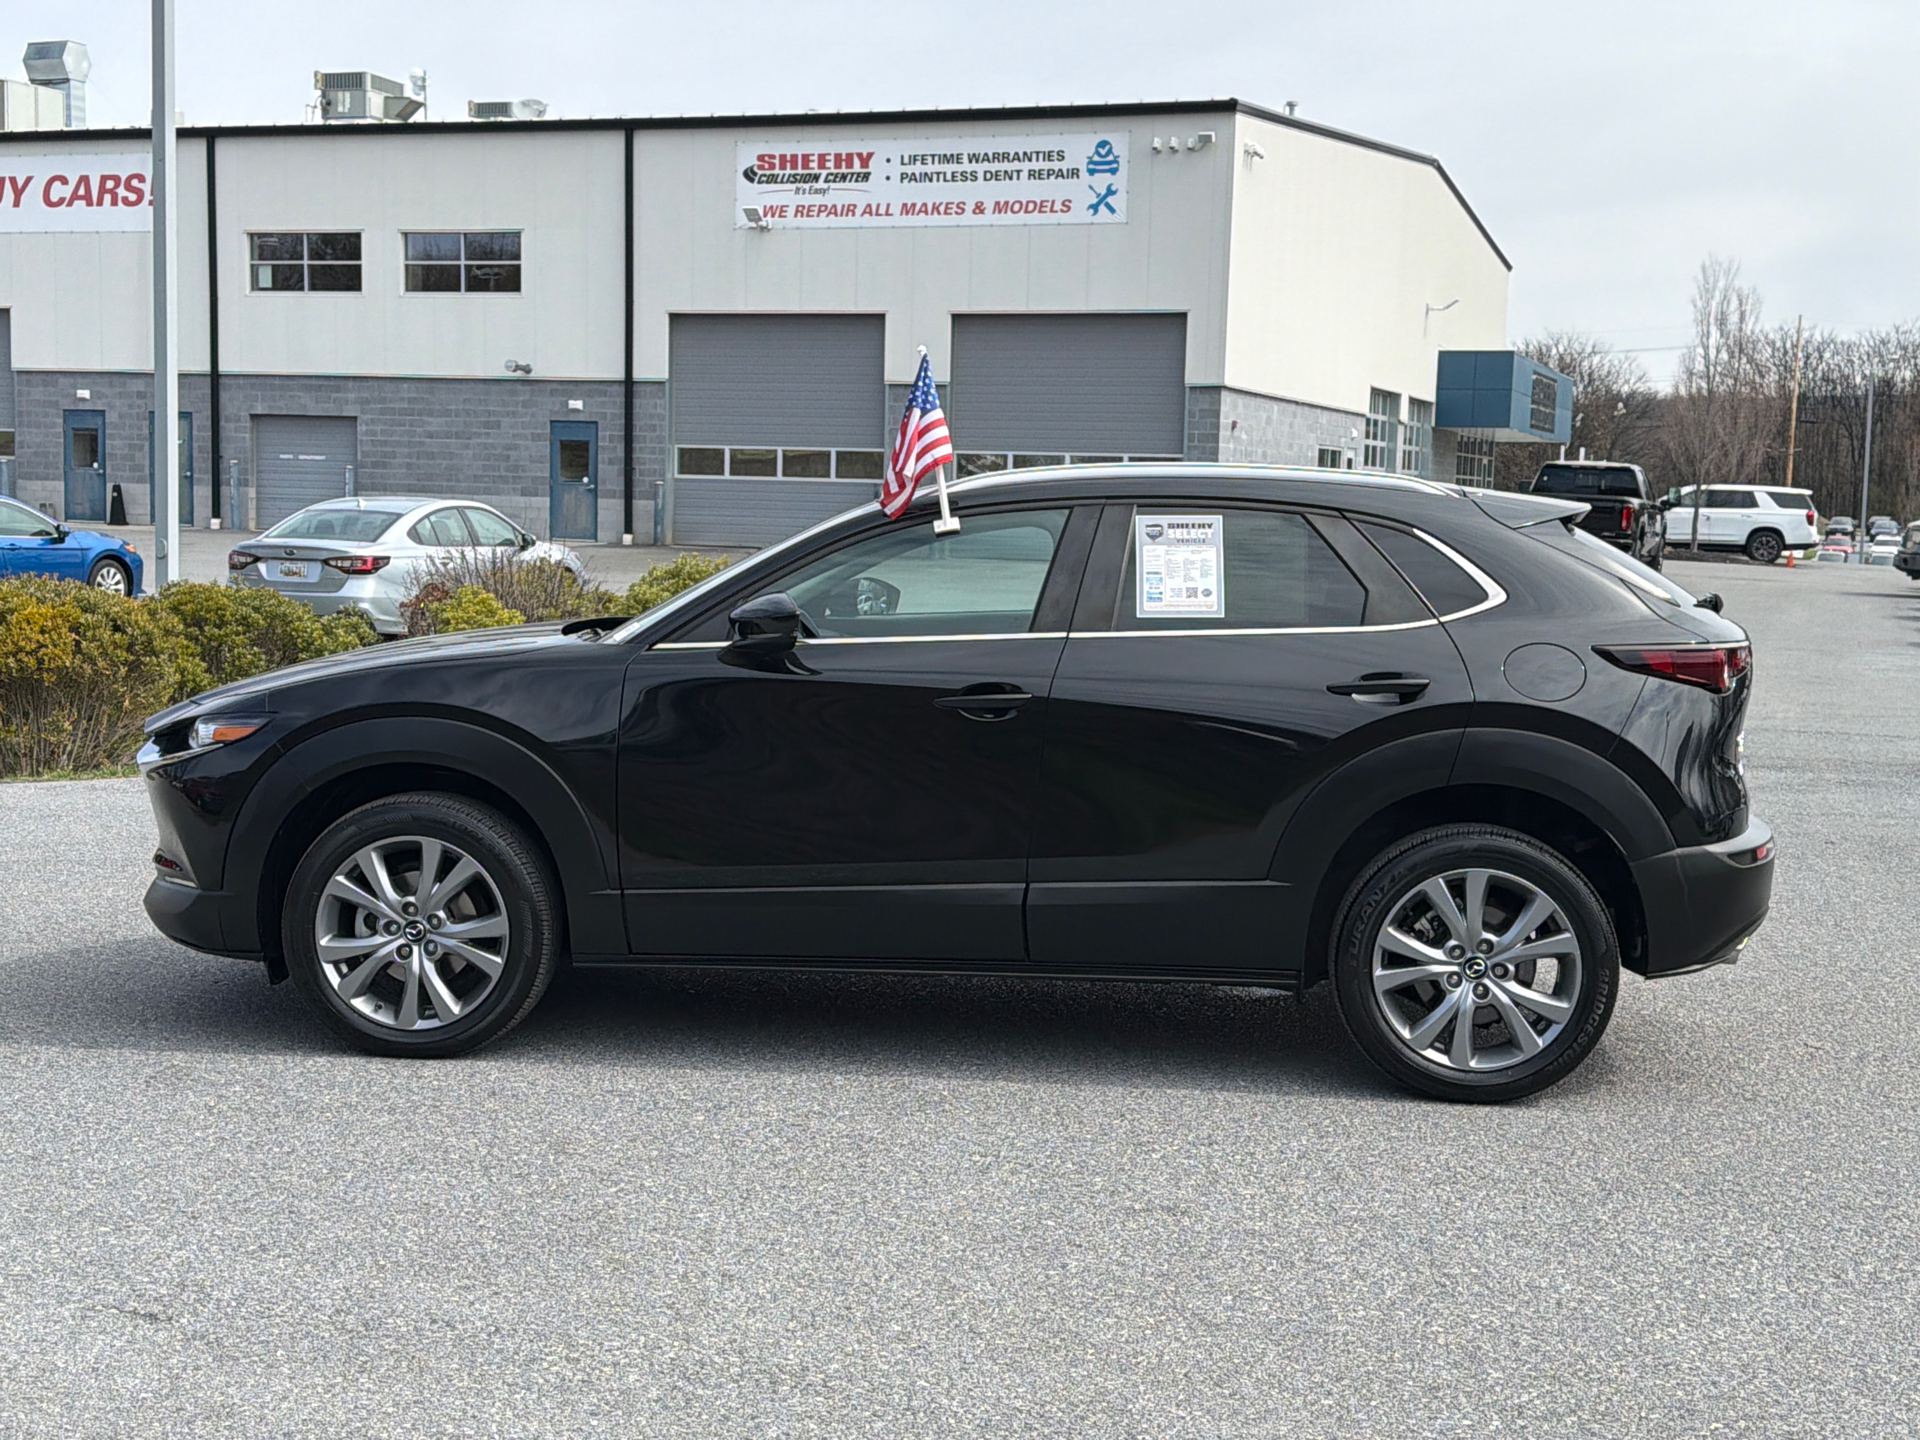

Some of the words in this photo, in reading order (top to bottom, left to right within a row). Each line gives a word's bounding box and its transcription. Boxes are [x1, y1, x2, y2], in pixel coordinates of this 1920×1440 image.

[756, 151, 875, 171] SHEEHY
[899, 154, 965, 166] LIFETIME
[967, 149, 1066, 164] WARRANTIES
[756, 172, 822, 185] COLLISION
[822, 171, 872, 184] CENTER
[899, 170, 979, 184] PAINTLESS
[982, 169, 1024, 182] DENT
[1026, 167, 1081, 181] REPAIR
[794, 186, 807, 196] It's
[808, 185, 831, 197] Easy!
[762, 204, 790, 219] WE
[793, 203, 858, 219] REPAIR
[860, 203, 894, 217] ALL
[900, 201, 967, 217] MAKES
[971, 201, 987, 216] &
[992, 199, 1072, 215] MODELS
[1167, 529, 1215, 539] SELECT
